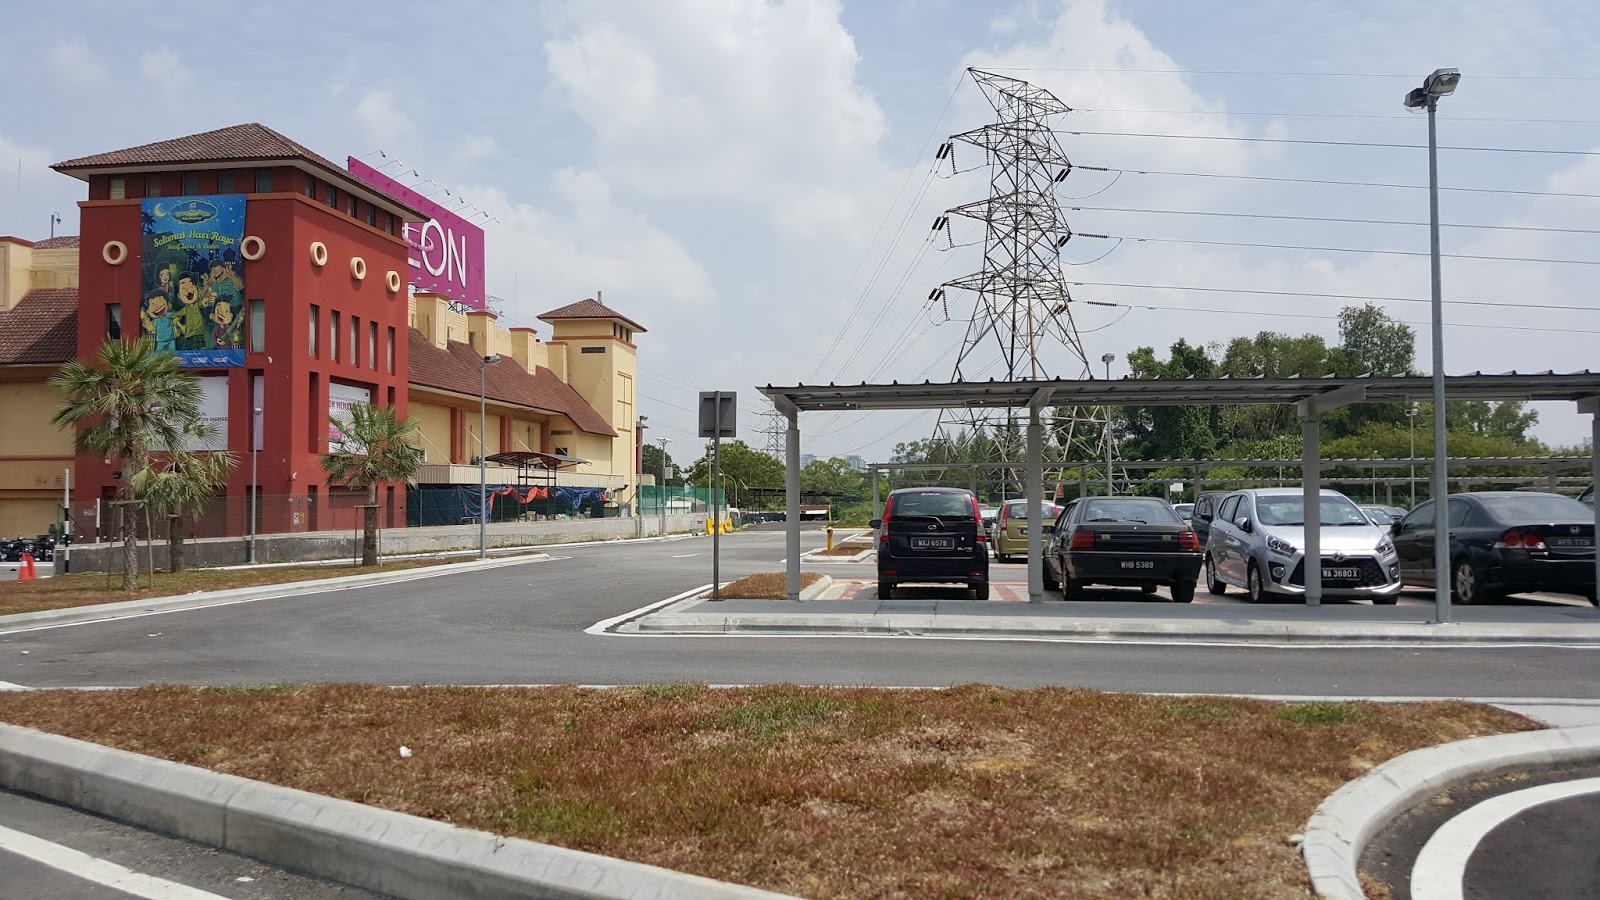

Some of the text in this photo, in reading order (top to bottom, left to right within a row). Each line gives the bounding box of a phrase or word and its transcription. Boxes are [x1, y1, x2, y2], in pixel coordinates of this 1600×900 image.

[153, 229, 235, 248] Selamat Hari Raya
[918, 539, 948, 547] WXJ 6578
[1120, 561, 1154, 569] WHB 5389
